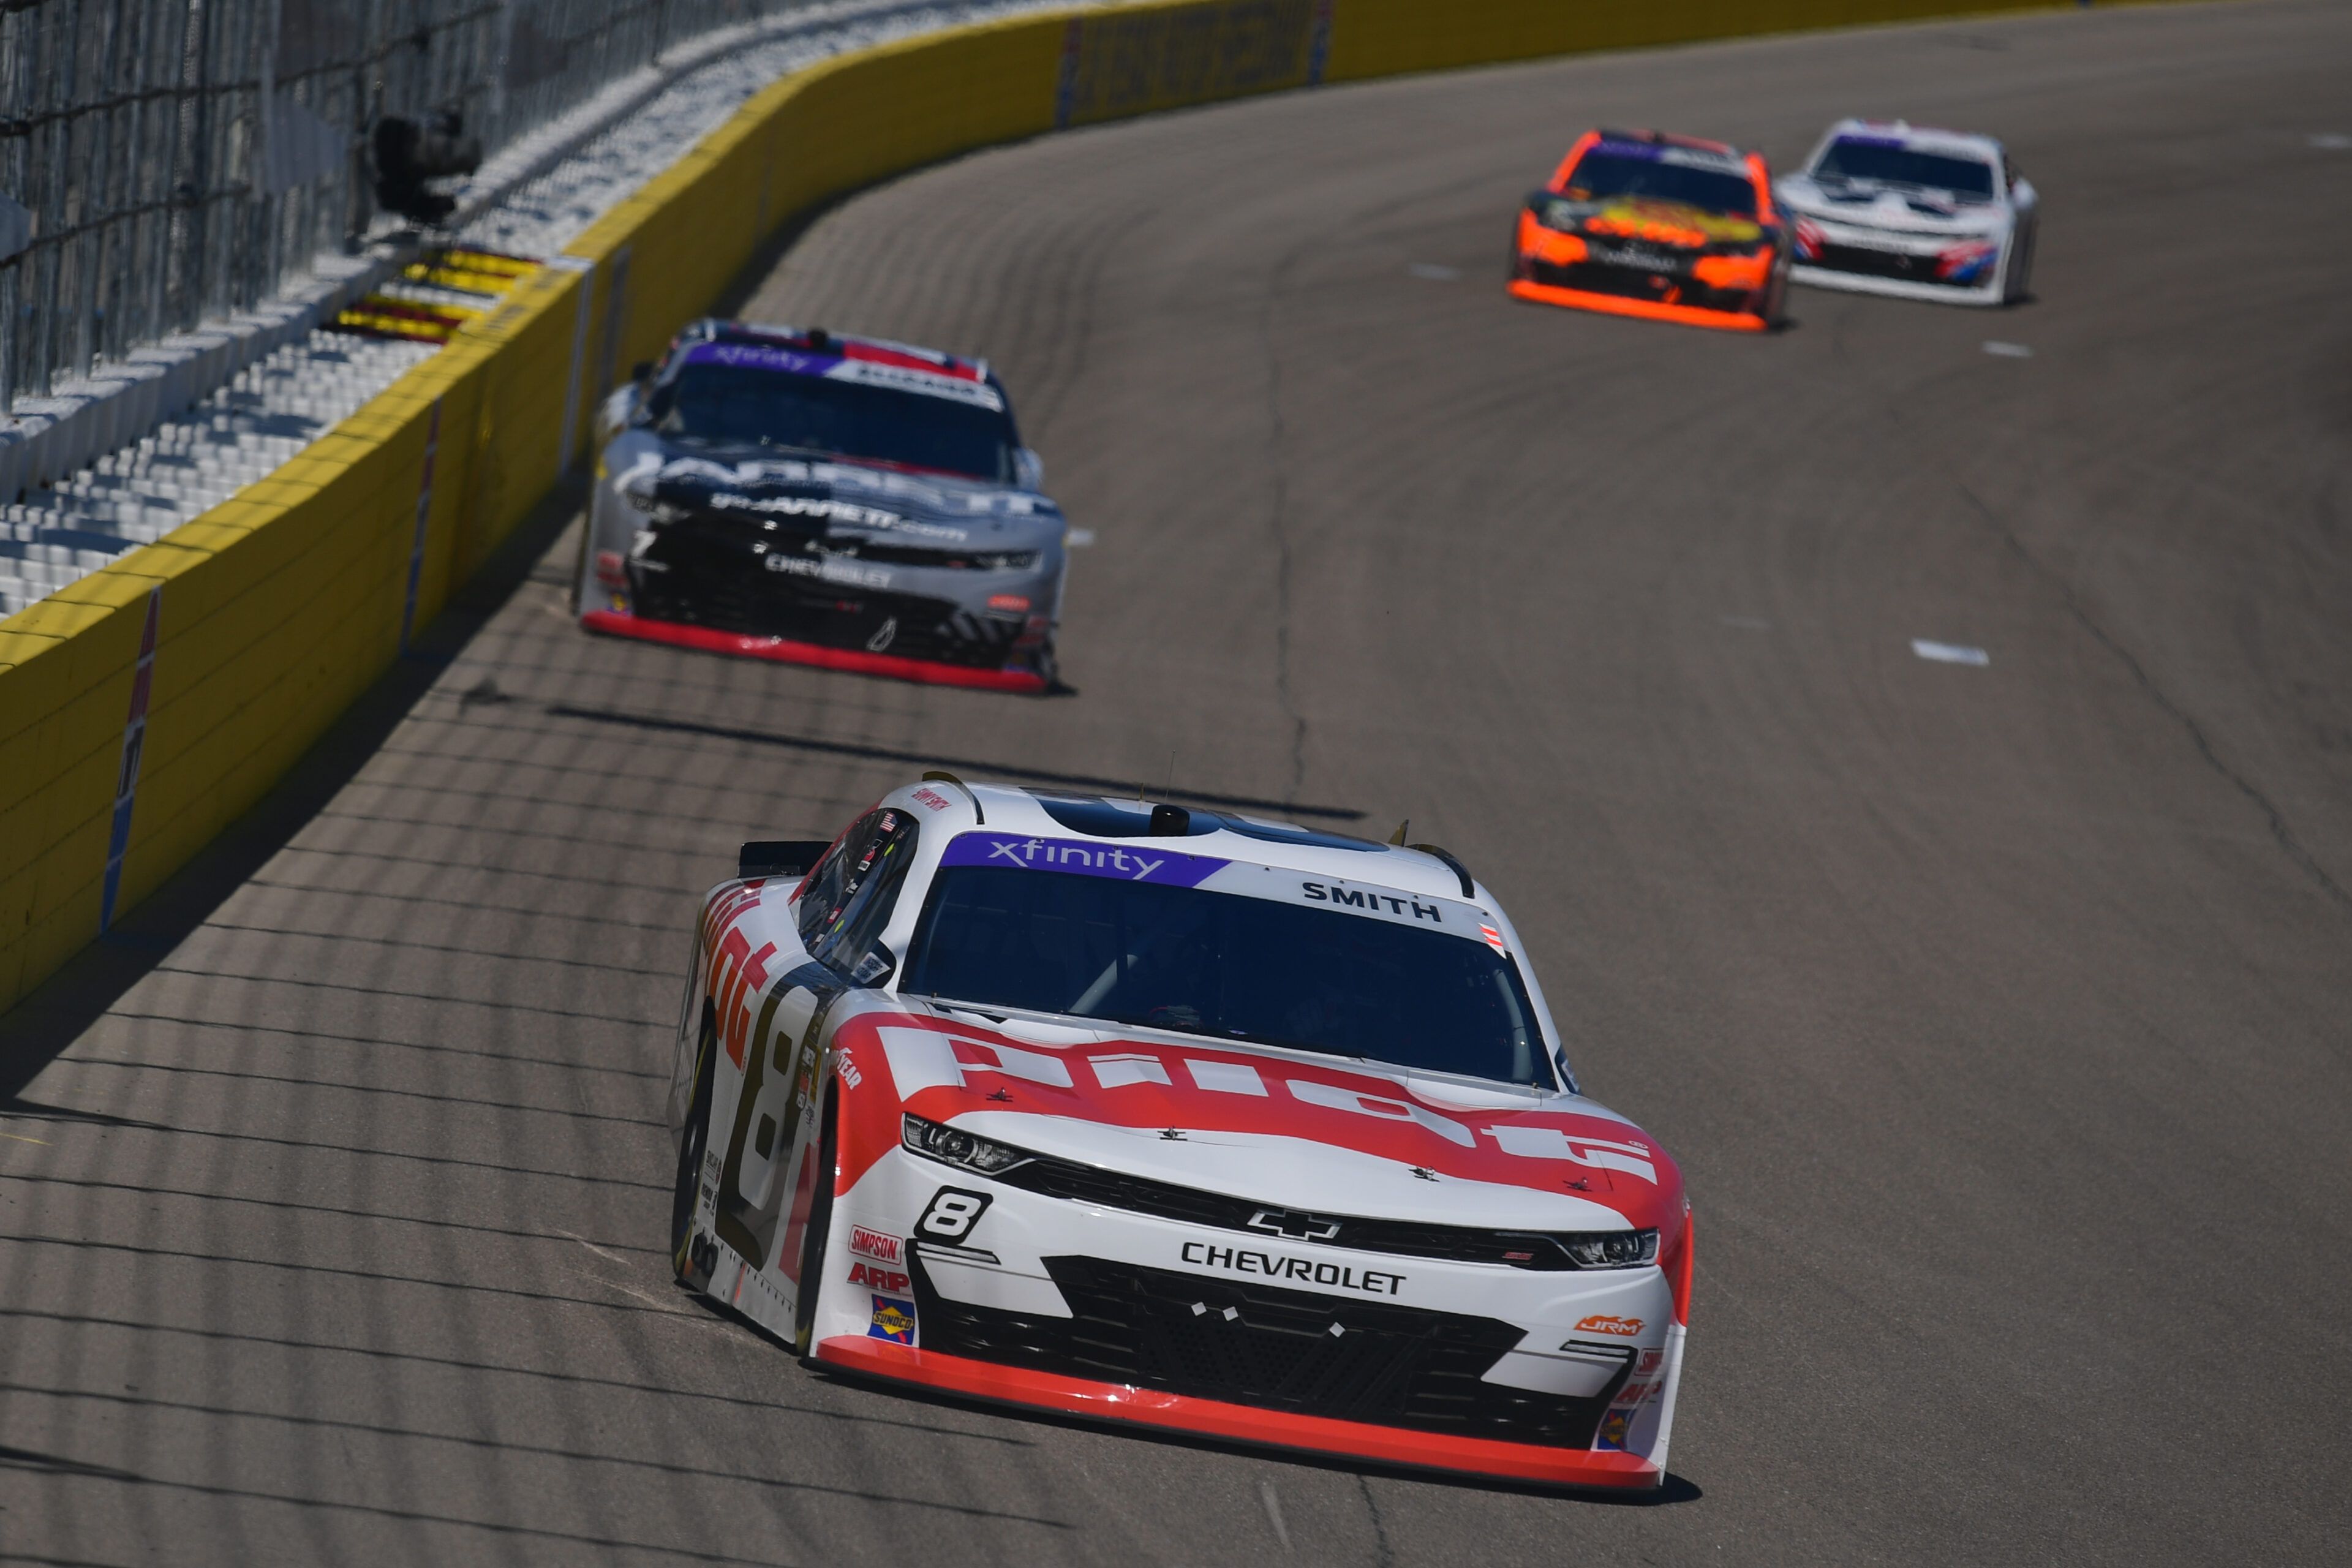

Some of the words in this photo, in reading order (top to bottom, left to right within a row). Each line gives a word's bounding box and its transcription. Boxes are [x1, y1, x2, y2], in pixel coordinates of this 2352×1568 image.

[631, 530, 657, 557] 7
[987, 839, 1164, 880] xfinity
[1302, 881, 1442, 922] SMITH
[919, 1189, 987, 1240] 8
[851, 1229, 898, 1260] SIMPSON
[848, 1262, 910, 1292] ARP
[1181, 1242, 1407, 1295] CHEVROLET
[873, 1312, 913, 1329] SUNOCO
[1581, 1320, 1639, 1335] JRM
